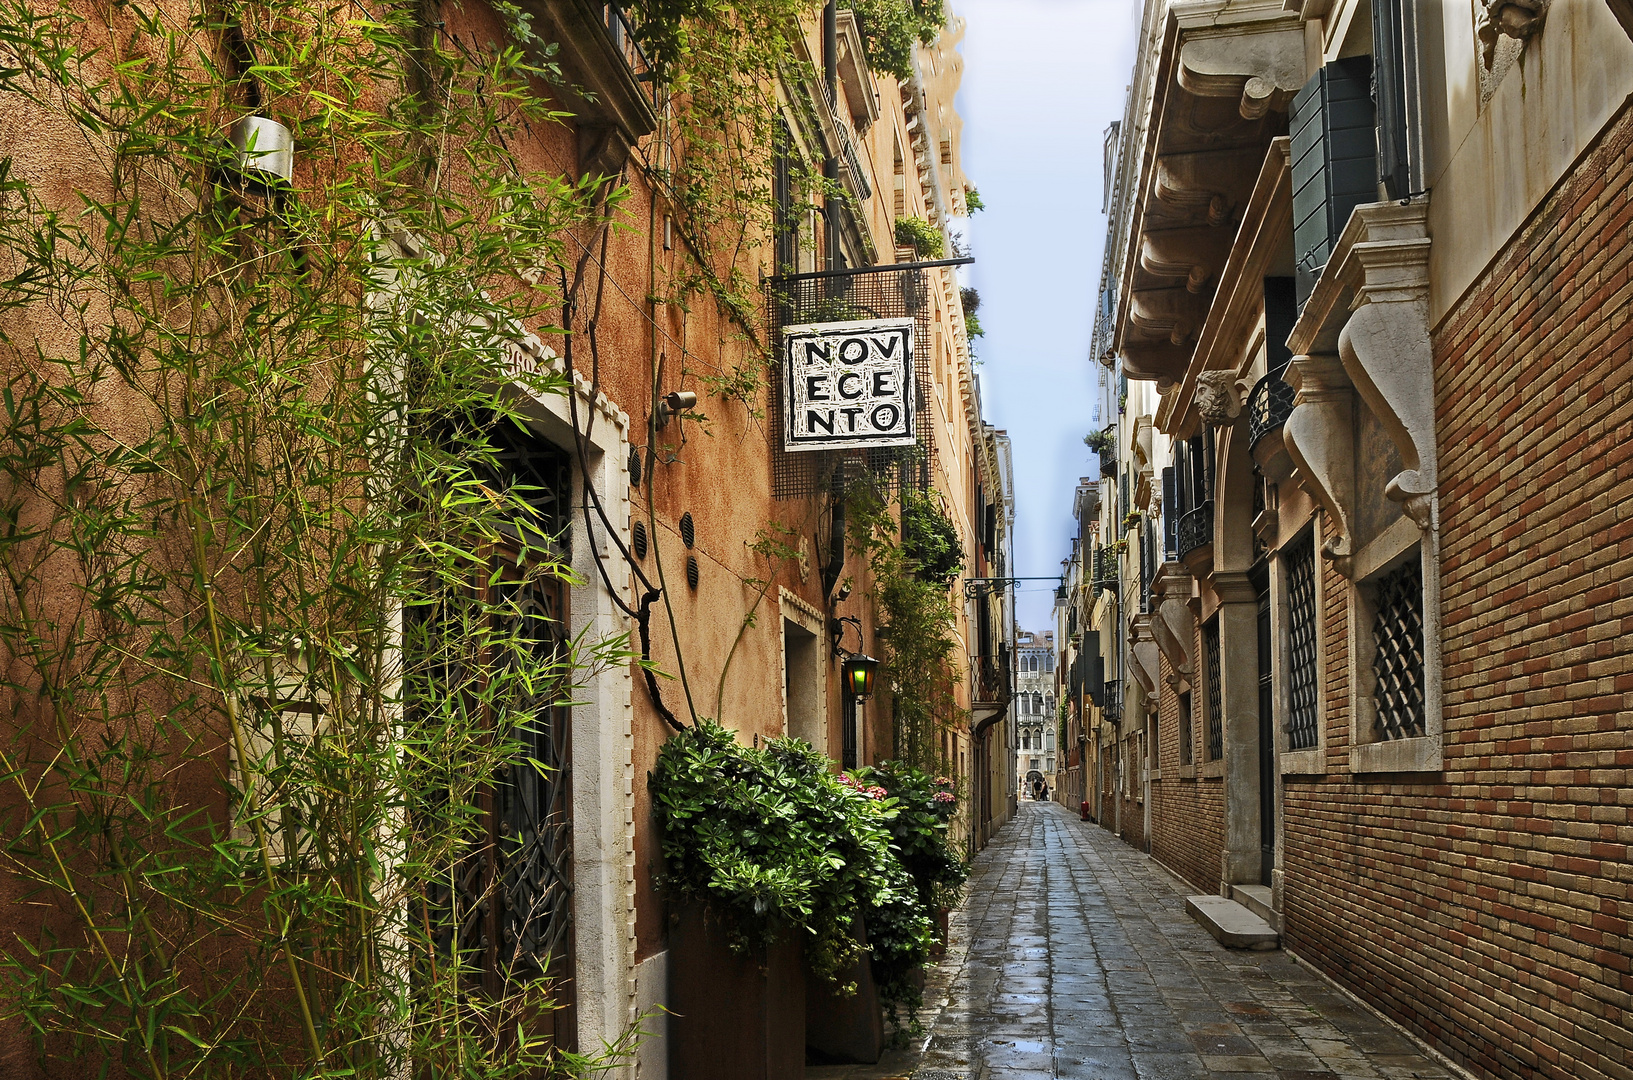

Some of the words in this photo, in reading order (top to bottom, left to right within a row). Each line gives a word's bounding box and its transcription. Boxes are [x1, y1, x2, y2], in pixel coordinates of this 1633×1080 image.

[805, 335, 900, 365] NOV
[806, 371, 896, 401] ECE
[807, 403, 900, 435] NTO
